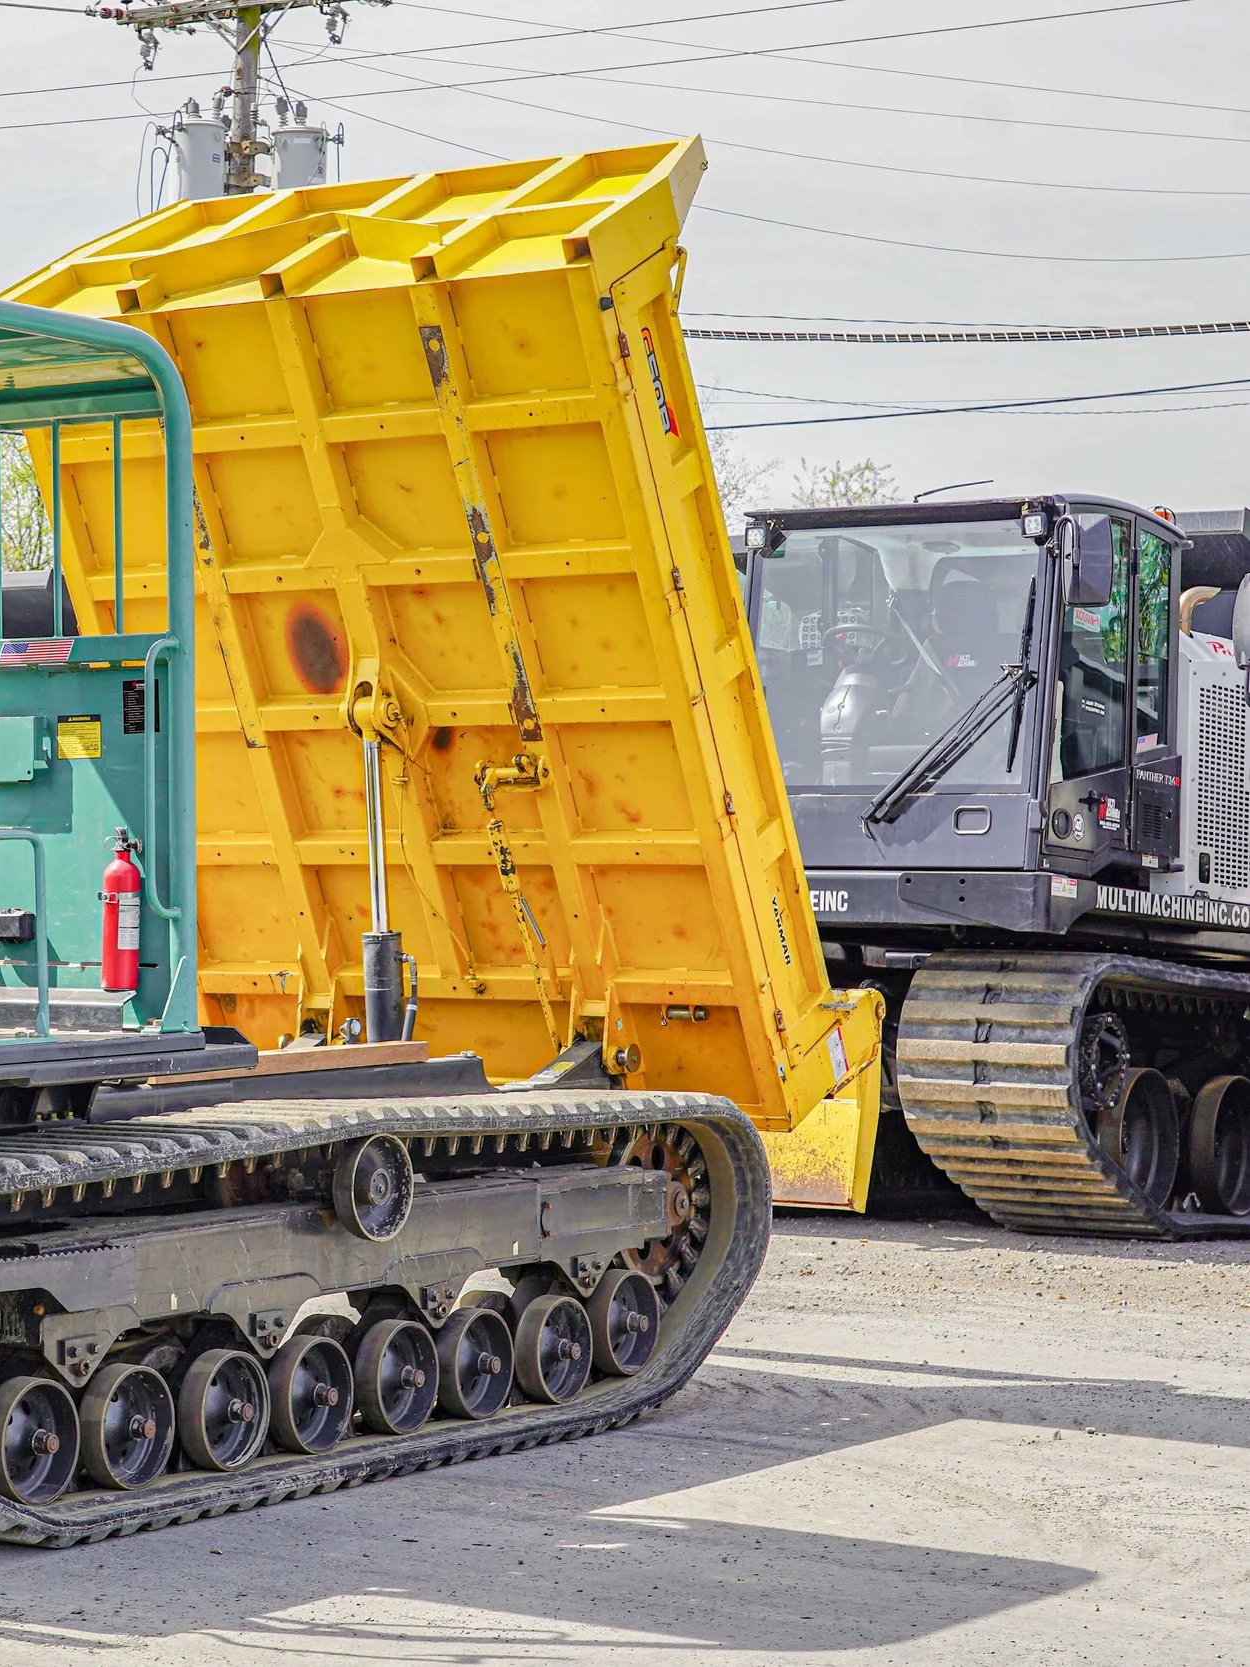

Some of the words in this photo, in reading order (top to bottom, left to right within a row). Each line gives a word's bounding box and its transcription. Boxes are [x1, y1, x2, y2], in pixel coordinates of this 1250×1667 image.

[1136, 768, 1163, 784] PANTHER
[810, 890, 848, 912] EINC
[772, 896, 791, 966] YANMAR
